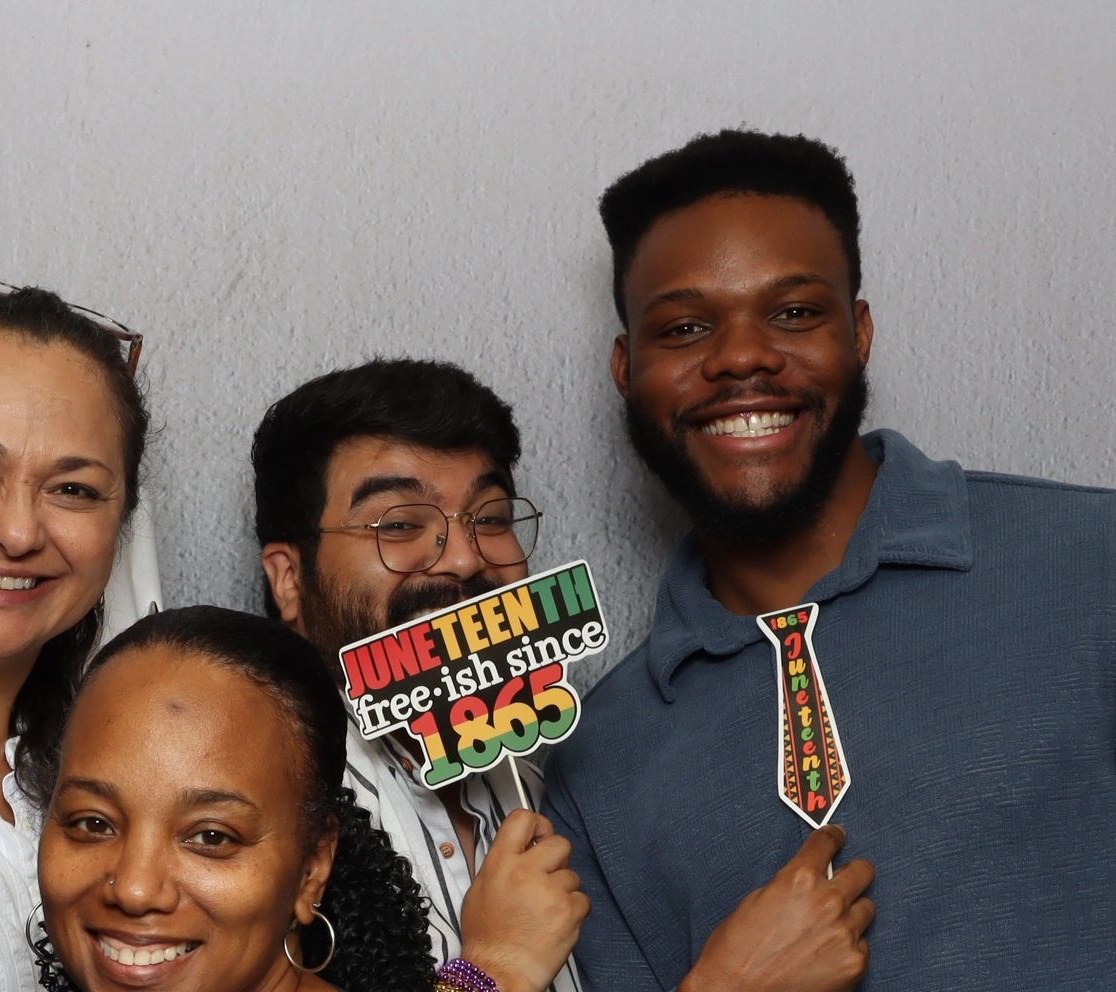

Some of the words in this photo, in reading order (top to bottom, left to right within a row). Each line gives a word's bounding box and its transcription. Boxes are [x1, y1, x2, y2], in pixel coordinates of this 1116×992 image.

[342, 565, 597, 700] JUNETEENTH
[506, 620, 605, 677] since
[770, 611, 809, 630] 1865
[410, 661, 576, 786] 1865
[784, 631, 827, 812] Juneteenth
